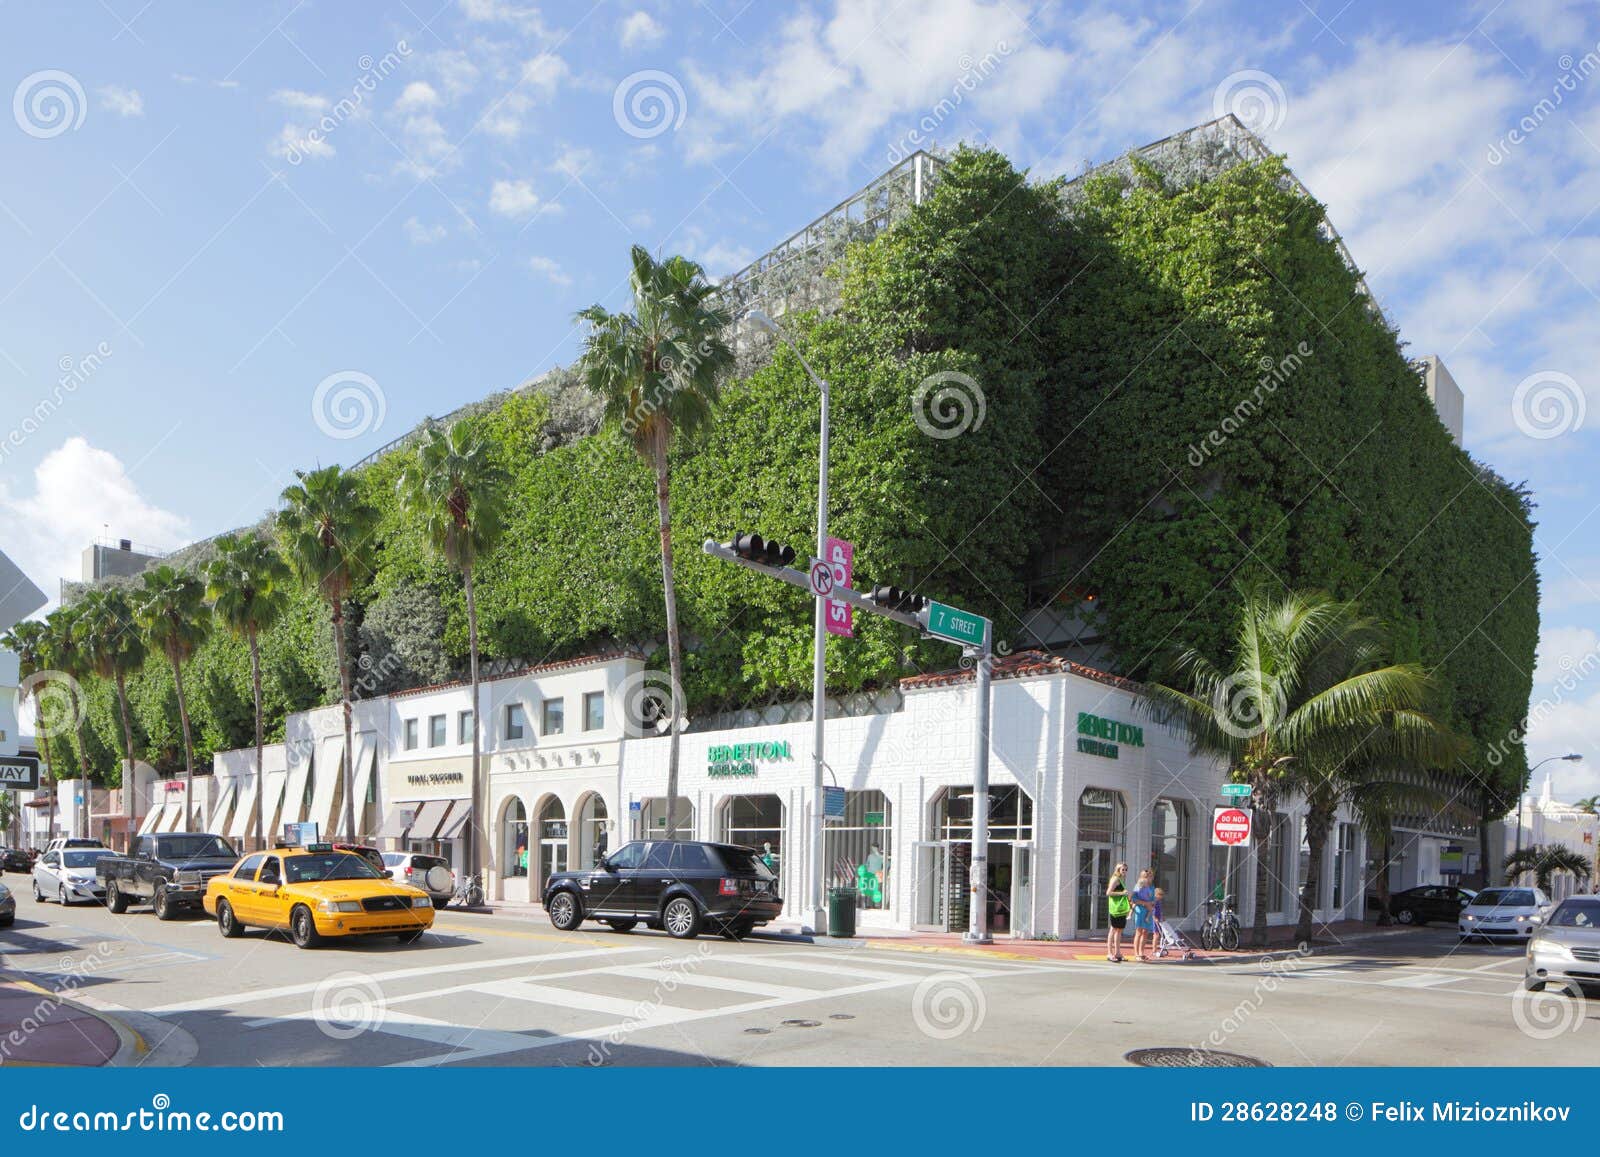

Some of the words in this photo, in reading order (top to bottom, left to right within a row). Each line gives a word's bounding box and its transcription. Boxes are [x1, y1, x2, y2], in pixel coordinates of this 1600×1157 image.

[938, 611, 945, 627] 7
[950, 616, 976, 636] STREET
[1077, 712, 1145, 748] BENETTON
[707, 740, 792, 763] BENETTON
[1221, 815, 1231, 823] DO
[1232, 815, 1246, 823] NOT
[1220, 831, 1243, 839] ENTER
